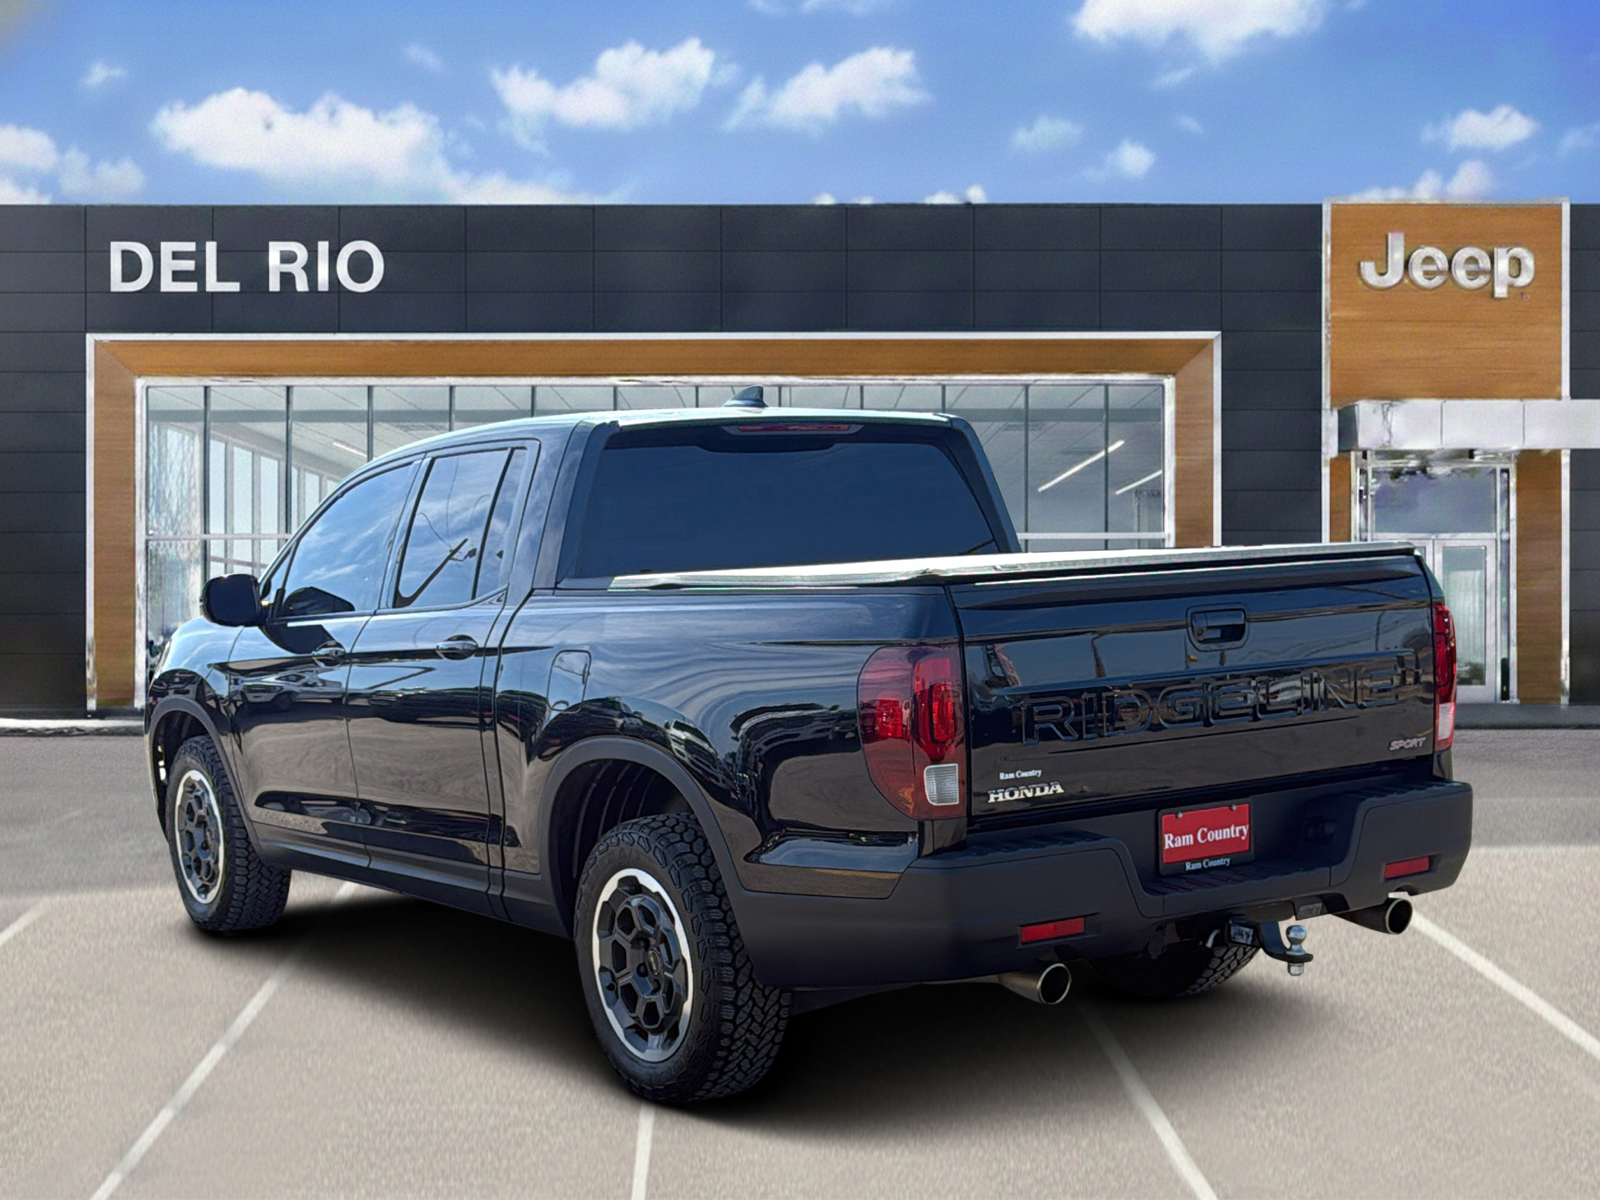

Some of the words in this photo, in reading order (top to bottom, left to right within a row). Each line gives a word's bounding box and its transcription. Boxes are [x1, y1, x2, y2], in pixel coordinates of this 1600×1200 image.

[110, 241, 241, 292] DEL
[268, 240, 385, 293] RIO
[1360, 231, 1535, 298] Jeep
[1022, 665, 1400, 745] RIDGELINE
[1389, 737, 1427, 751] SPORT
[999, 772, 1016, 780] Ram
[1015, 769, 1042, 779] Country
[987, 781, 1065, 803] HONDA
[1163, 833, 1194, 850] Ram
[1196, 824, 1249, 843] Country
[1185, 861, 1202, 871] Ram
[1202, 857, 1231, 868] Country
